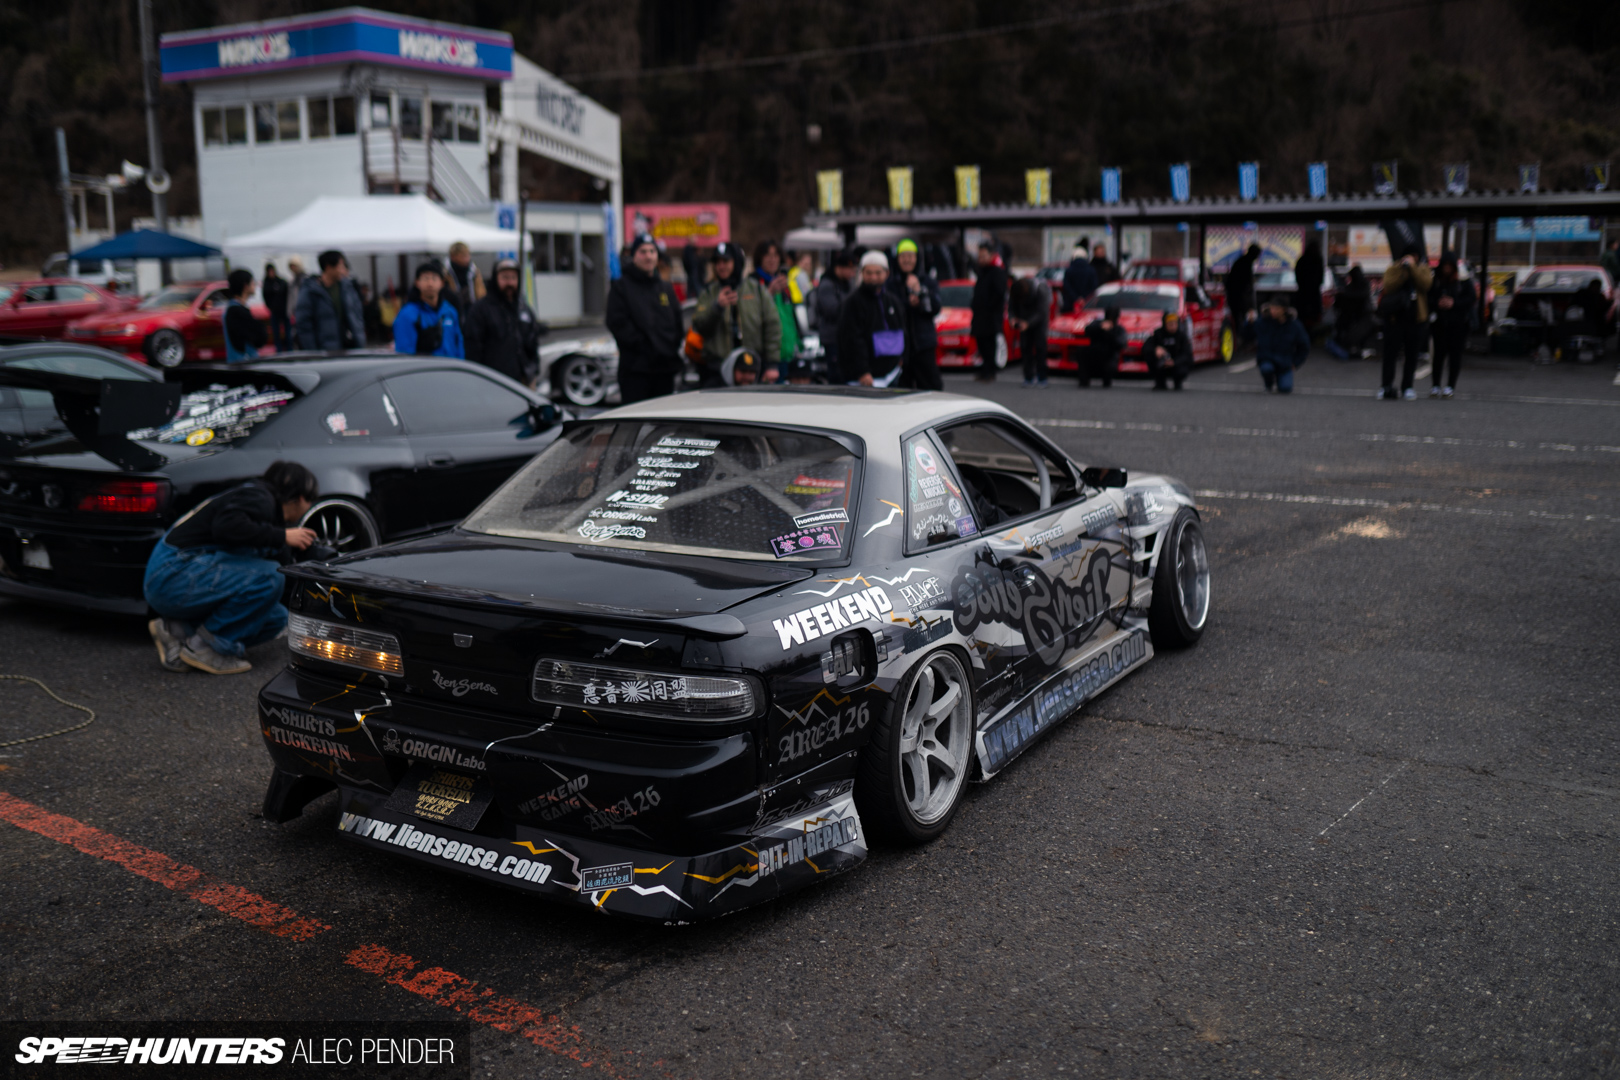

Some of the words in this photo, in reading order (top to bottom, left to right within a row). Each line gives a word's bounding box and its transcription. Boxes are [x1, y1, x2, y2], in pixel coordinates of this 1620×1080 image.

[602, 510, 639, 521] ORIGIN
[797, 512, 846, 526] homedistrict
[772, 585, 894, 651] WEEKEND
[983, 632, 1146, 768] www.liensense.com
[280, 707, 336, 737] SHIRTS
[778, 710, 843, 766] AREA
[843, 701, 870, 735] 26
[402, 739, 457, 764] ORIGIN
[456, 753, 487, 771] Labo.
[429, 771, 476, 790] SHIRTS
[517, 774, 589, 815] WEEKEND
[540, 796, 582, 821] GANG
[633, 784, 661, 813] 26
[338, 812, 552, 884] www.liensense.com
